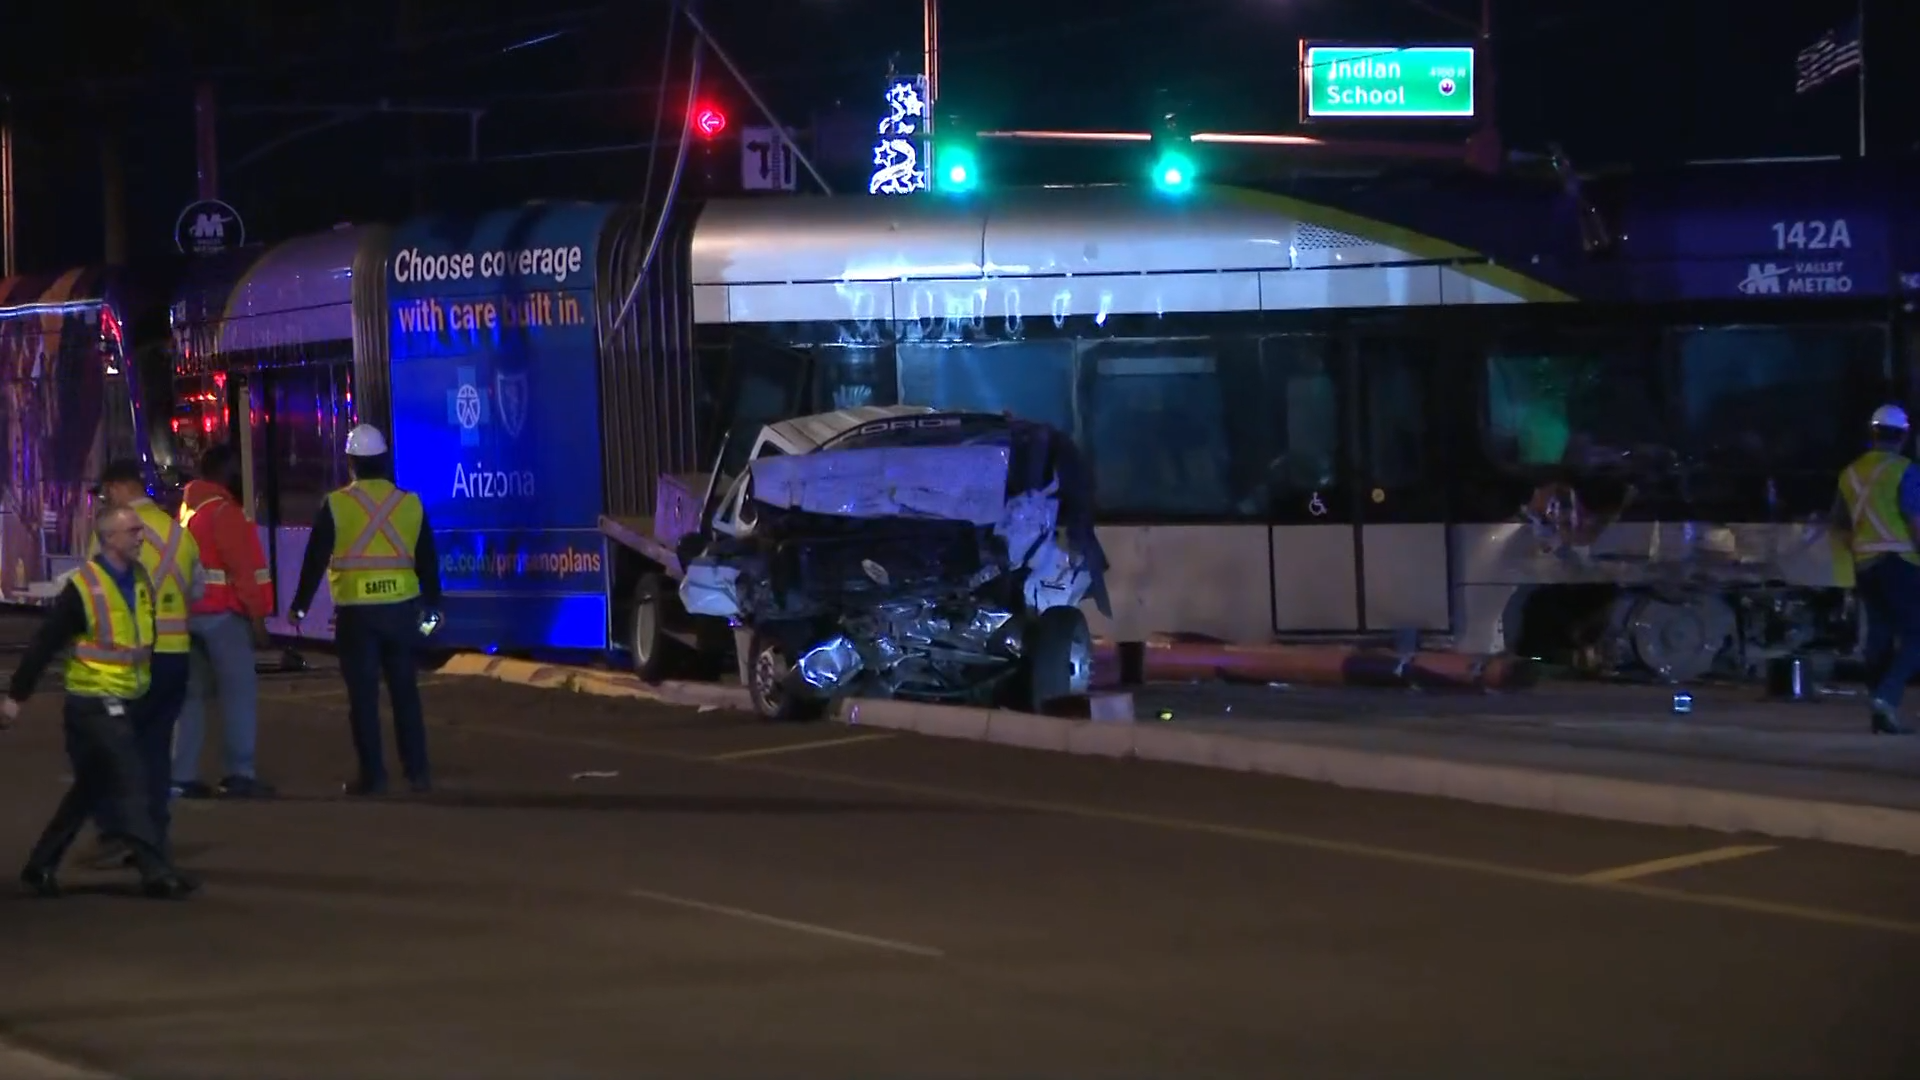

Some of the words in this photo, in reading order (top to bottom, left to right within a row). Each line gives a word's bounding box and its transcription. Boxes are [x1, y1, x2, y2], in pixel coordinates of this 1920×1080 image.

[1328, 58, 1401, 80] Indian
[1327, 85, 1405, 105] School
[1772, 219, 1851, 250] 142A
[395, 248, 474, 282] Choose
[481, 245, 582, 282] coverage
[1795, 261, 1844, 274] VALLEY
[1787, 276, 1852, 293] METRO
[399, 299, 444, 332] with
[450, 302, 497, 330] care
[502, 291, 552, 327] built
[558, 291, 585, 324] in.
[452, 461, 535, 499] Arizona
[365, 579, 397, 595] SAFETY
